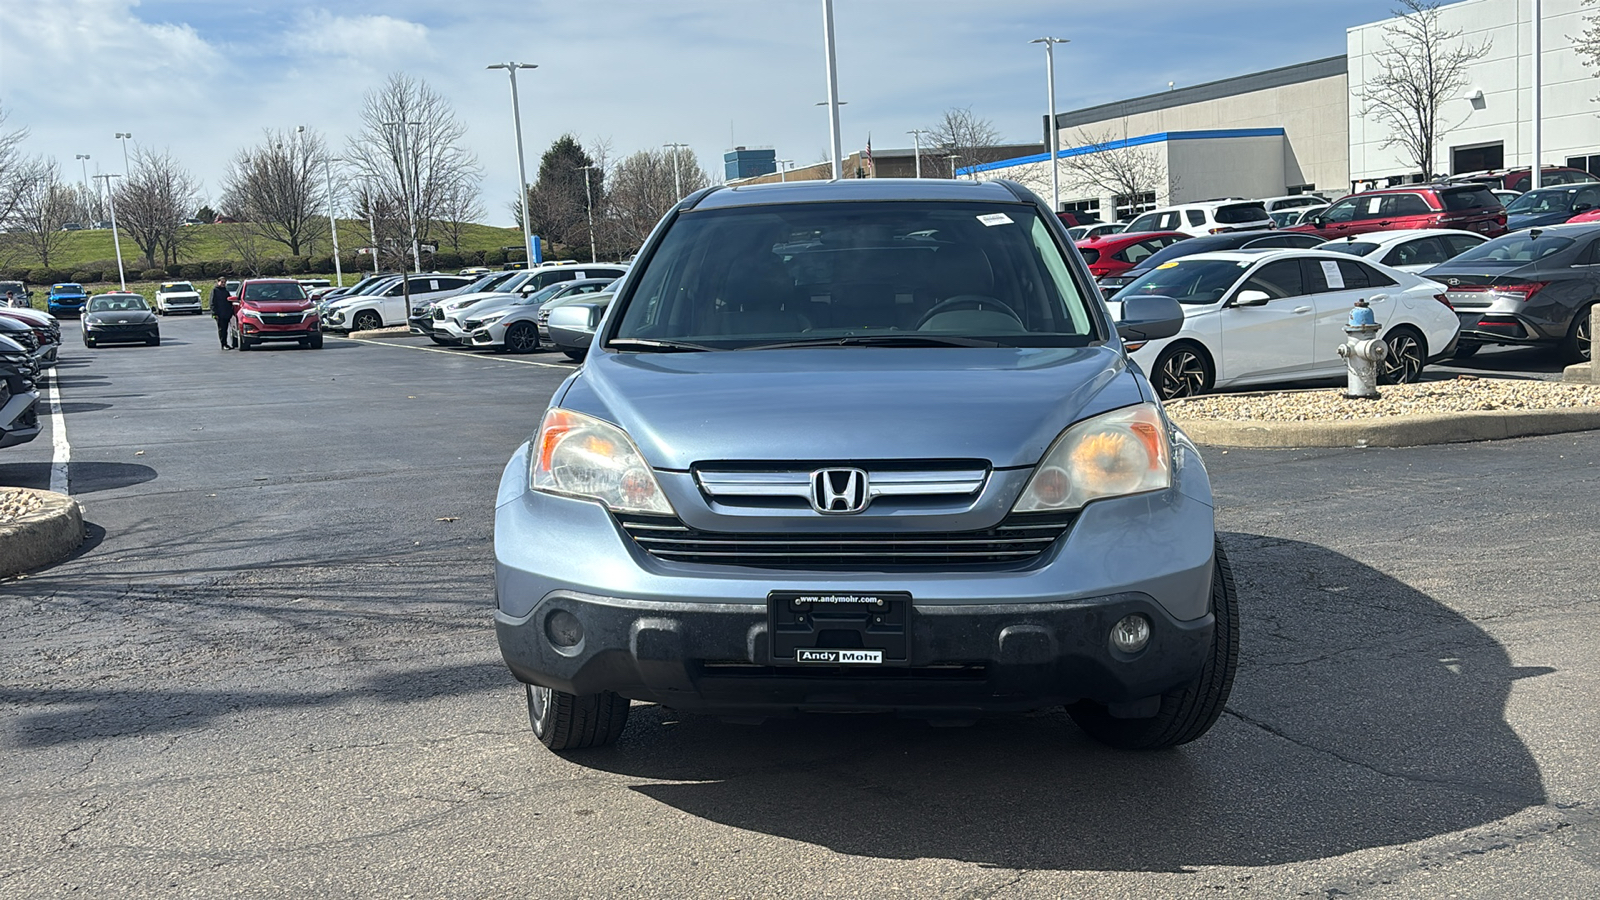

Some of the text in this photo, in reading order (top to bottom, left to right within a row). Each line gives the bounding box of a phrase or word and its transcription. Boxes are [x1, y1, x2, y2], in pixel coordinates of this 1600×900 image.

[800, 595, 877, 604] www.andymohr.com
[802, 652, 879, 661] Andy Mohr
